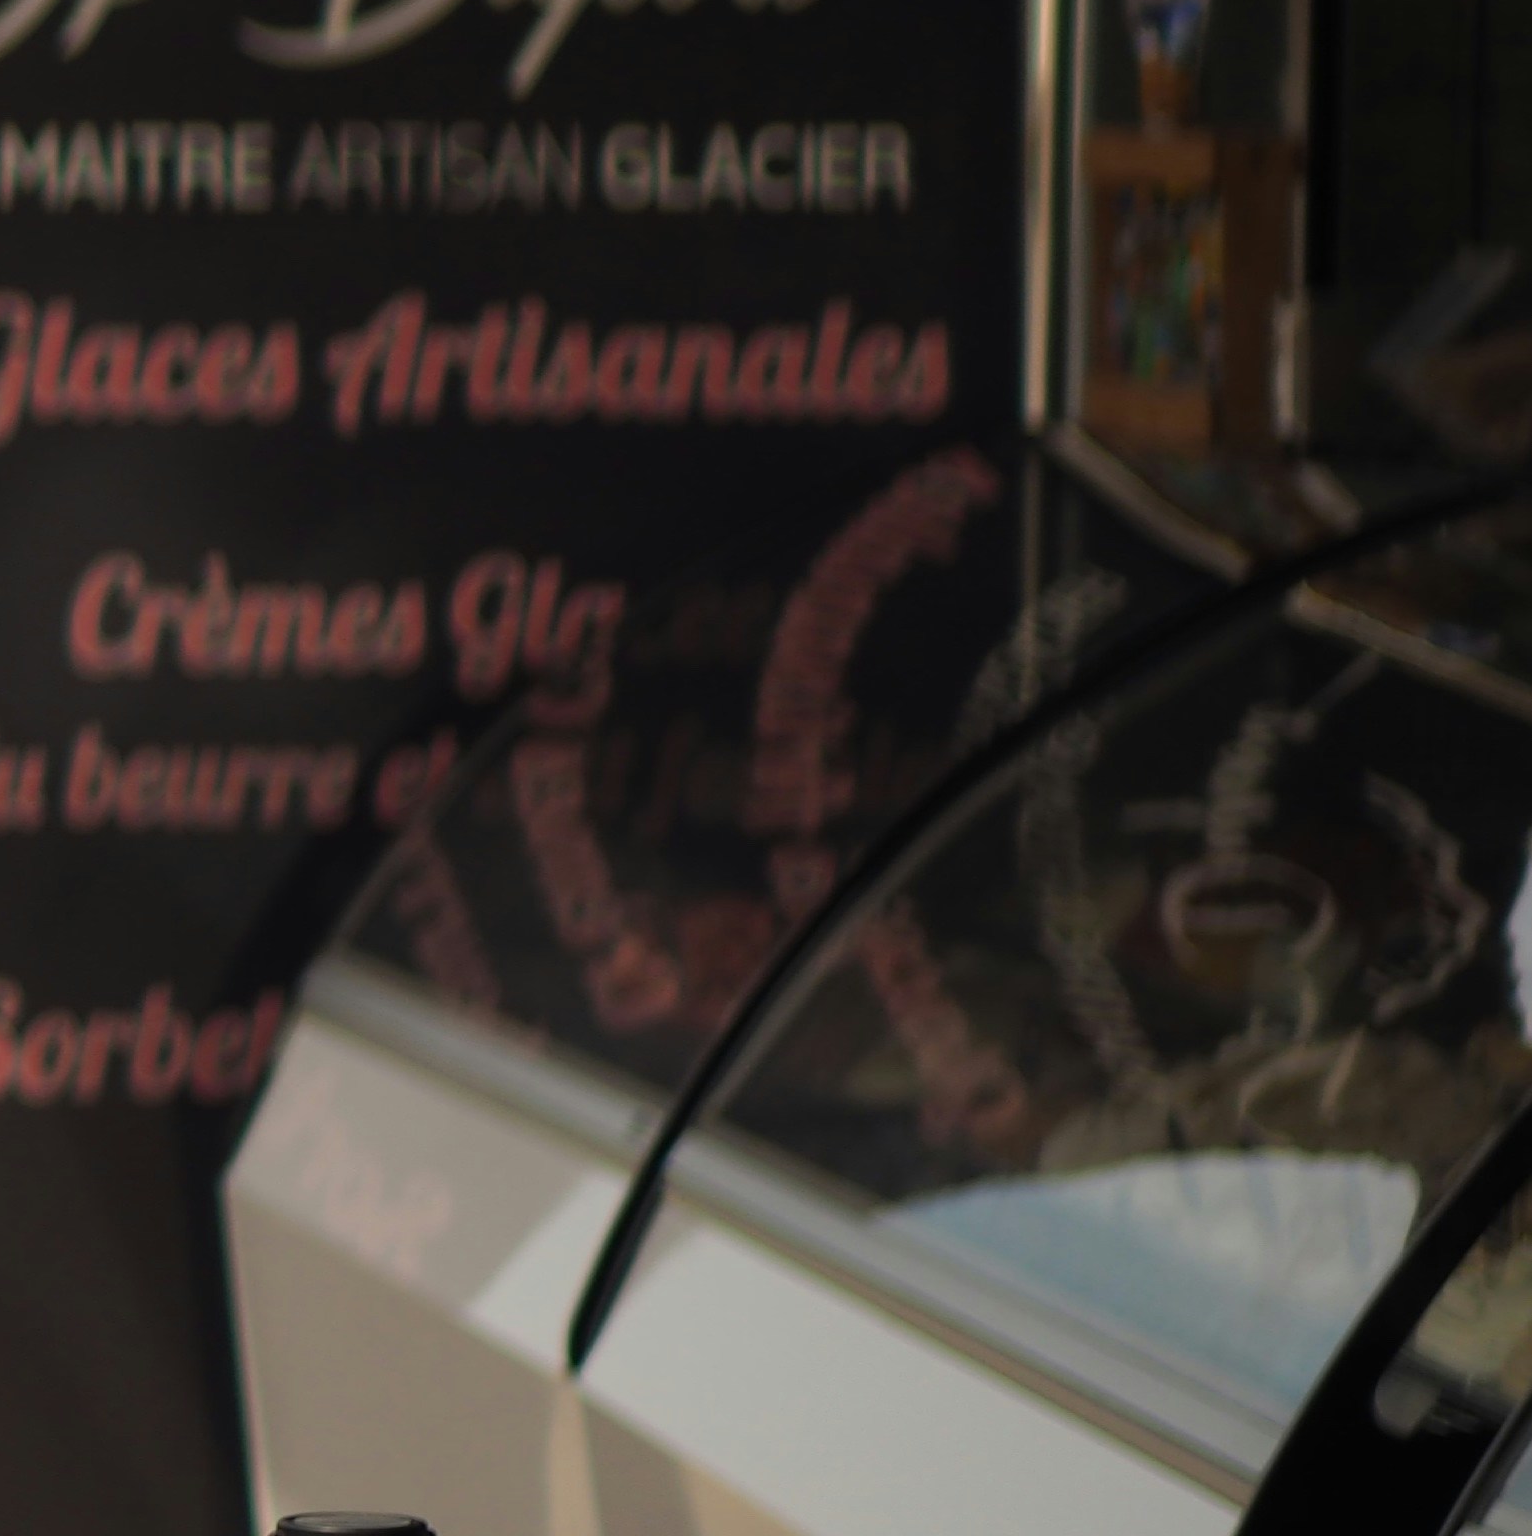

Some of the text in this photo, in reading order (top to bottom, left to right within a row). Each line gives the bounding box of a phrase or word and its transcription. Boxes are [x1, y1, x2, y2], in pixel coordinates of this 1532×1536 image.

[287, 120, 581, 212] ARTISAN
[600, 120, 912, 214] GLACIER
[325, 286, 949, 439] Artisanales
[67, 550, 426, 679] Crèmes
[64, 721, 357, 831] beurre
